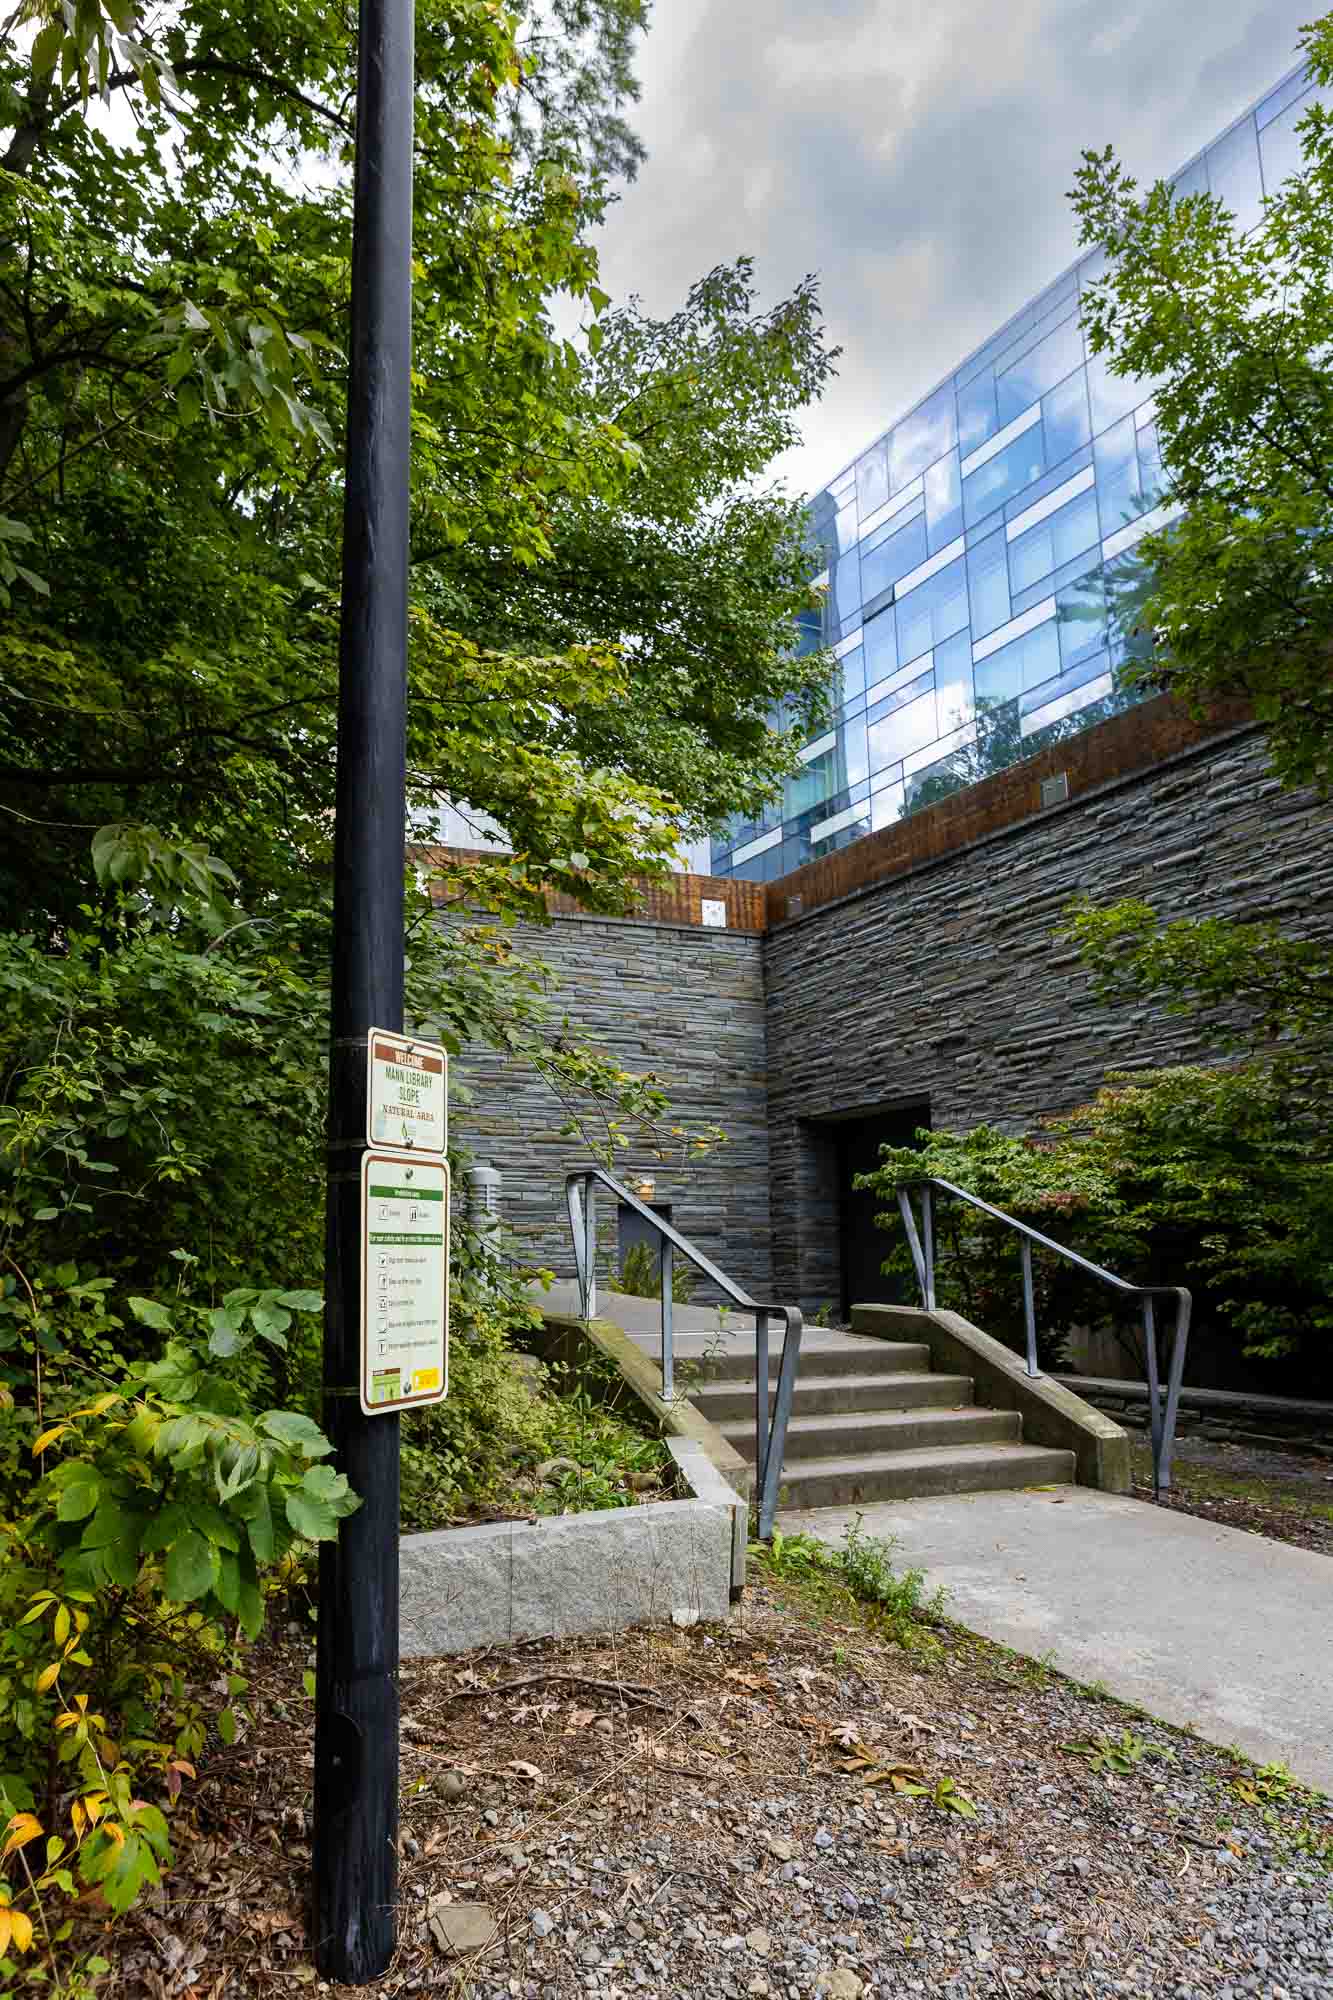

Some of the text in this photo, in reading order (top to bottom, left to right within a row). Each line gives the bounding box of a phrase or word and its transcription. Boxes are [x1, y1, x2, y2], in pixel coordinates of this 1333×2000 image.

[395, 1051, 424, 1068] WELCOME
[386, 1066, 433, 1088] MANN LIBRARY
[399, 1087, 420, 1103] SLOPE
[383, 1105, 415, 1118] NATURAL
